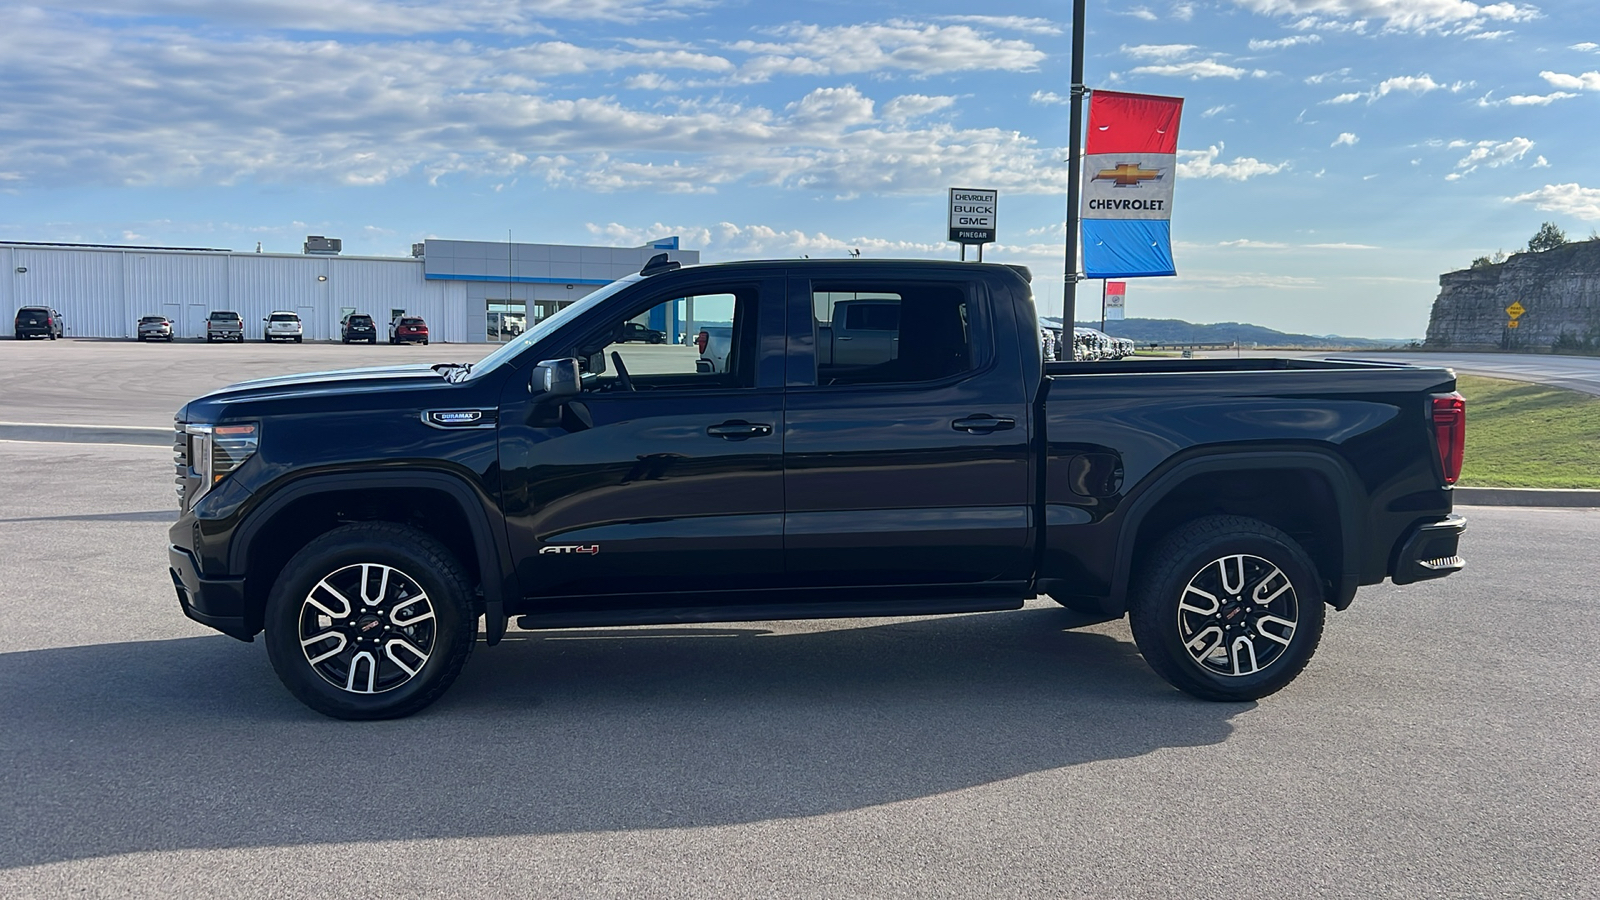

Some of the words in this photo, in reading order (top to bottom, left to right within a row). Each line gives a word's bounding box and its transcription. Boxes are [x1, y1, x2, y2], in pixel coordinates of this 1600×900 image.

[955, 194, 993, 202] CHEVROLET
[954, 205, 993, 214] BUICK
[959, 217, 988, 225] GMC
[958, 231, 987, 239] PINEGAR
[539, 544, 599, 556] AT4
